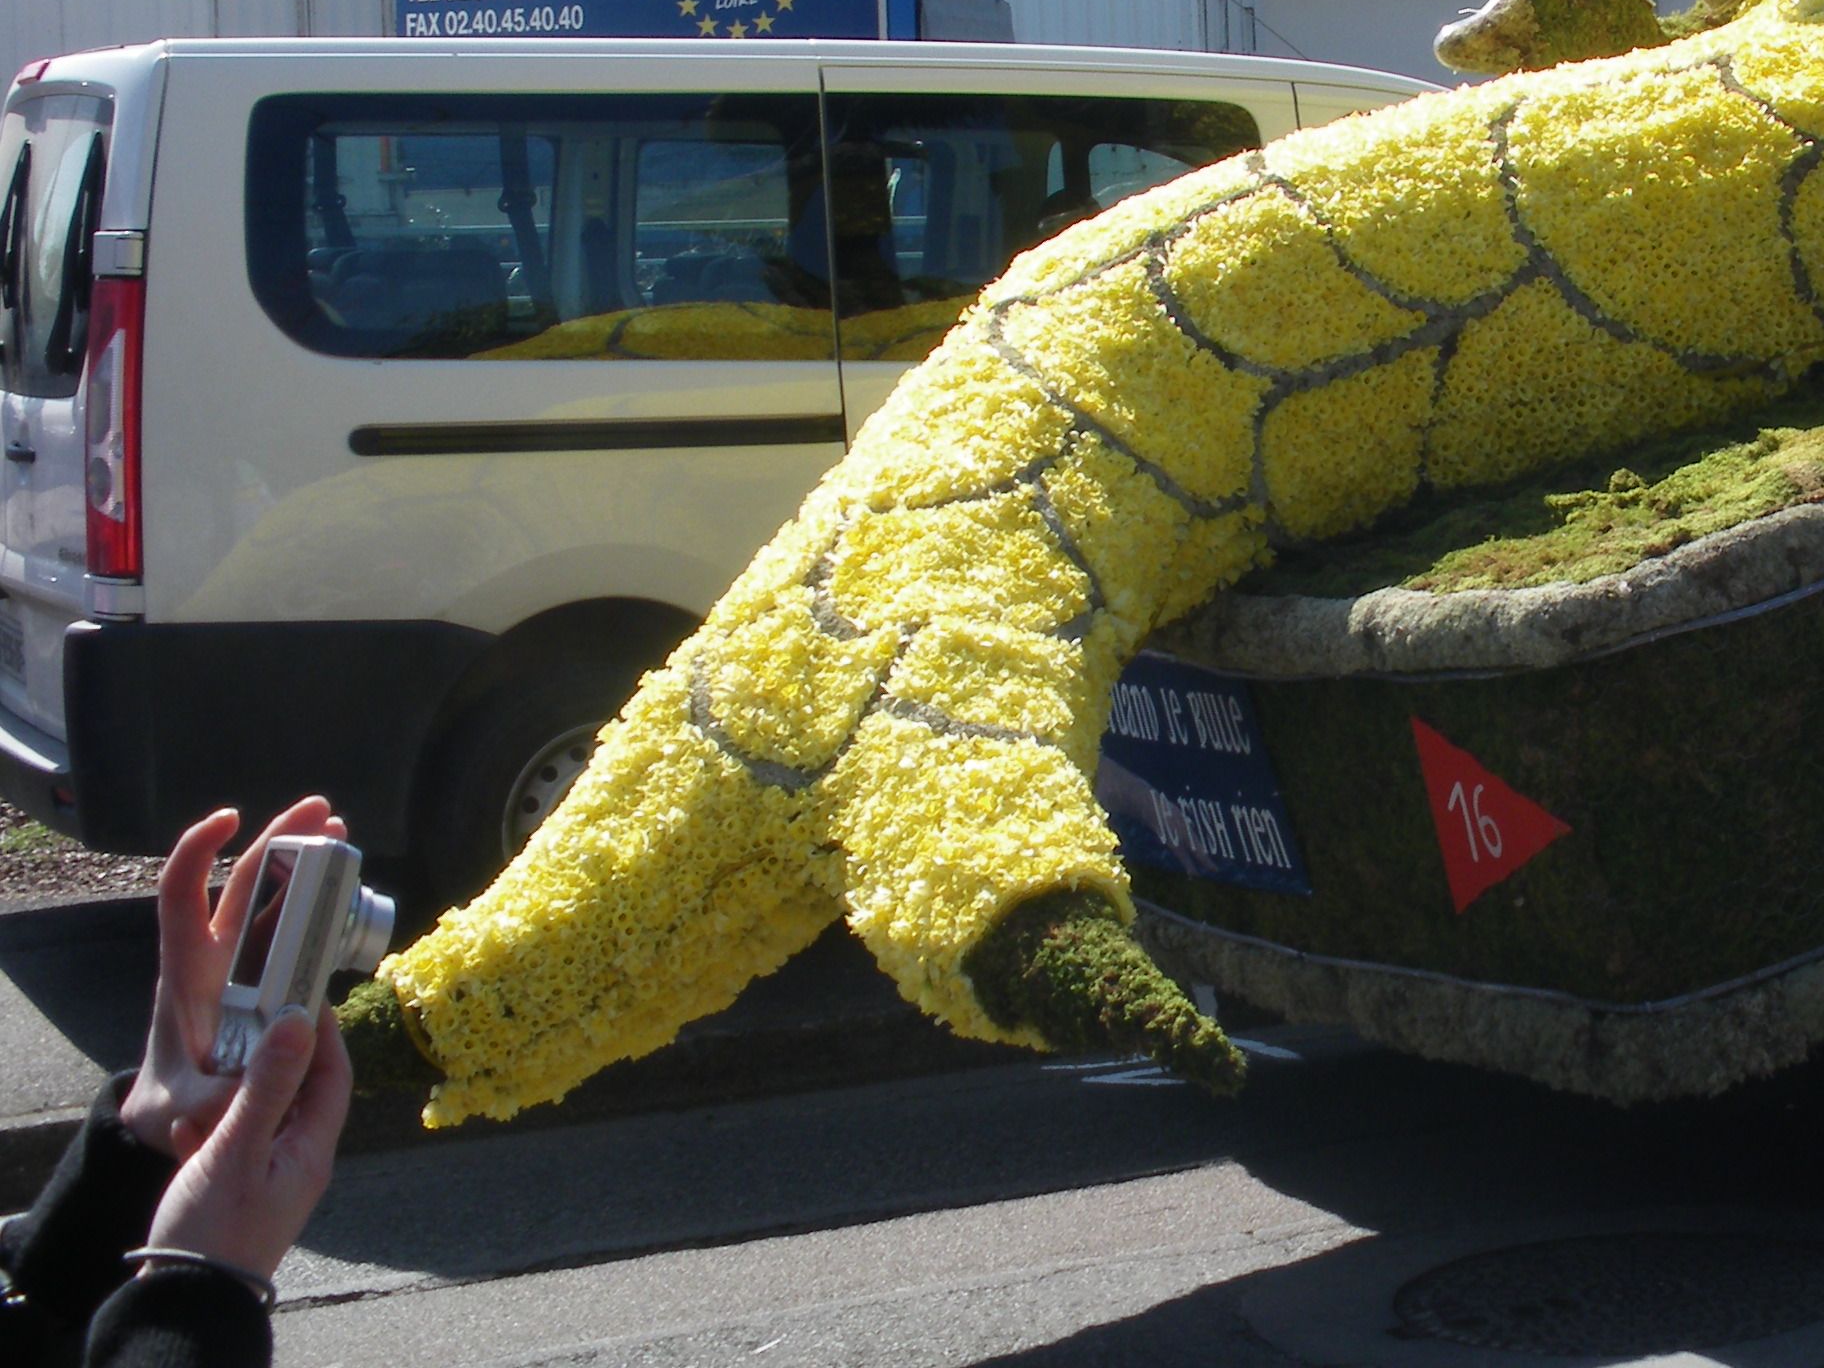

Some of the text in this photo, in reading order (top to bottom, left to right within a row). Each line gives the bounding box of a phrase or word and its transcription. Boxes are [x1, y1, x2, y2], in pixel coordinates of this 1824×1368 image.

[405, 5, 584, 36] FAX 02.40.45.40.40
[1447, 781, 1503, 863] 16
